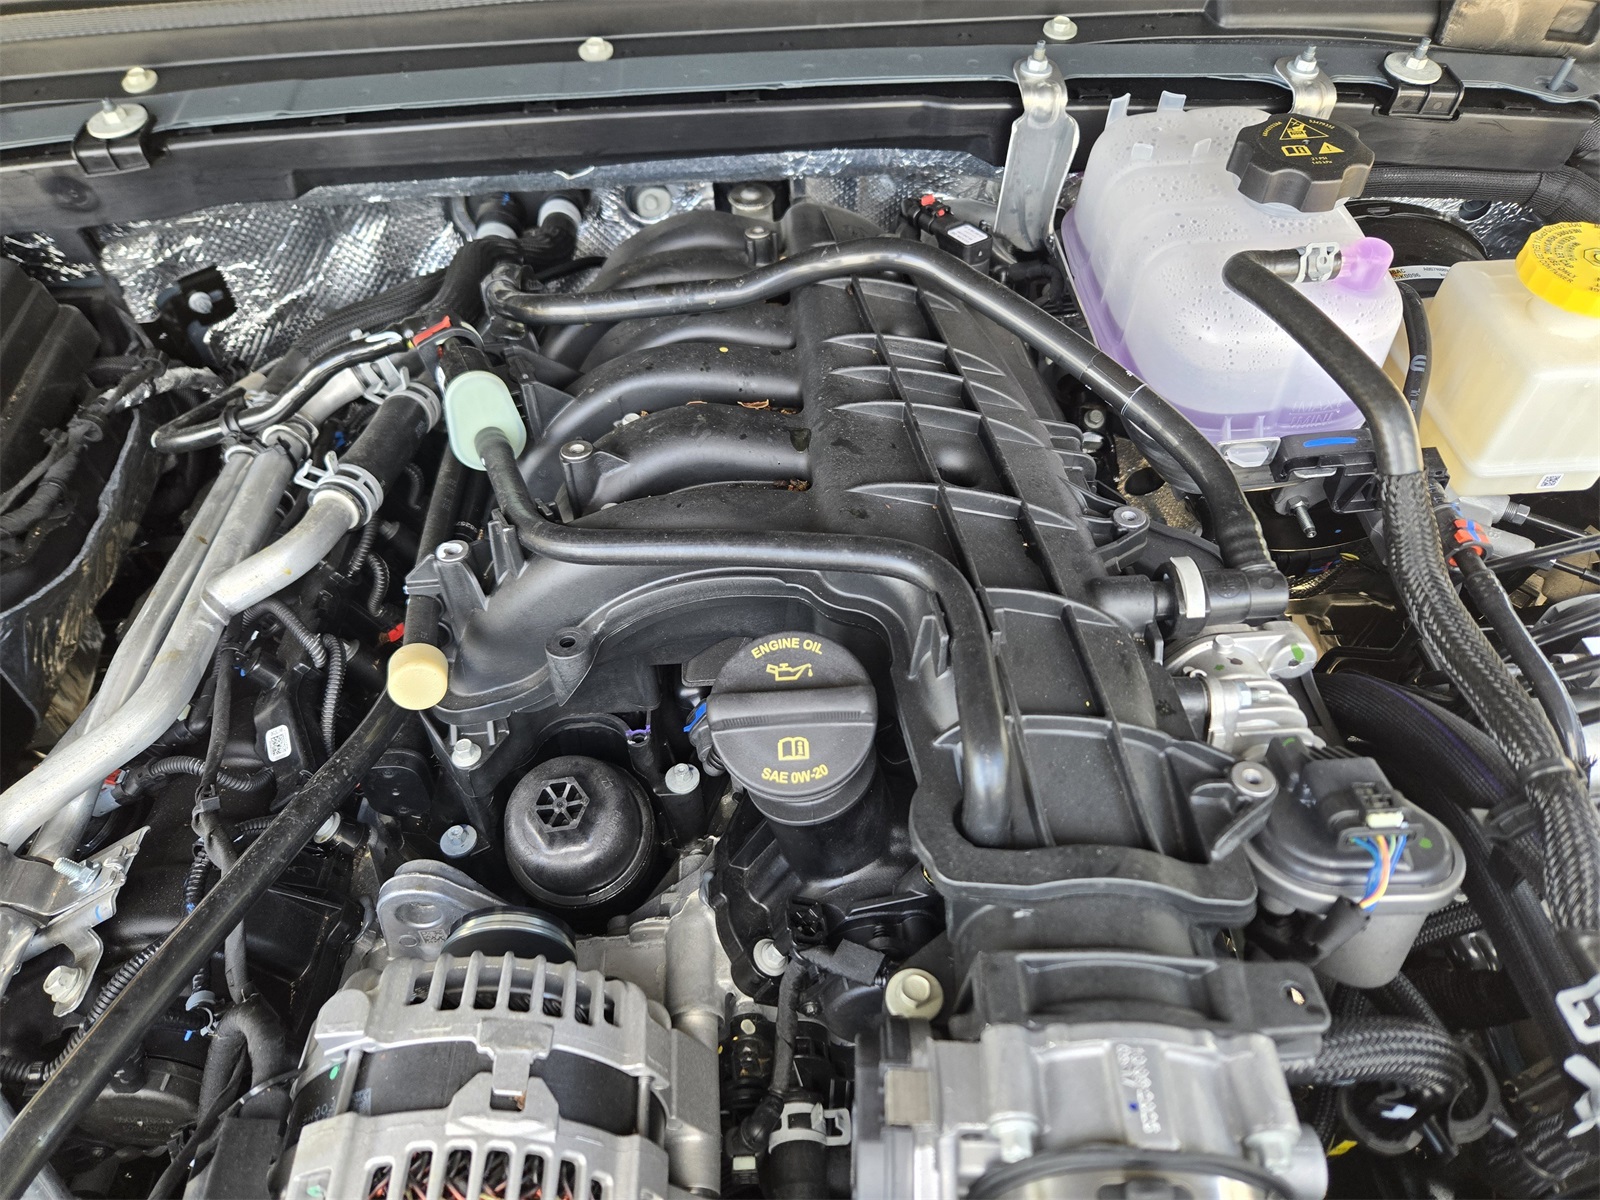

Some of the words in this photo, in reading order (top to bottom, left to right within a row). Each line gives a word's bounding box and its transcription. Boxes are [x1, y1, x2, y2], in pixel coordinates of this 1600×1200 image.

[1547, 257, 1561, 266] USE
[1558, 266, 1578, 278] ONLY
[1560, 259, 1574, 268] CAP
[751, 638, 801, 659] ENGINE
[802, 639, 823, 655] OIL
[761, 767, 788, 784] SAE
[791, 764, 829, 784] 0W-20
